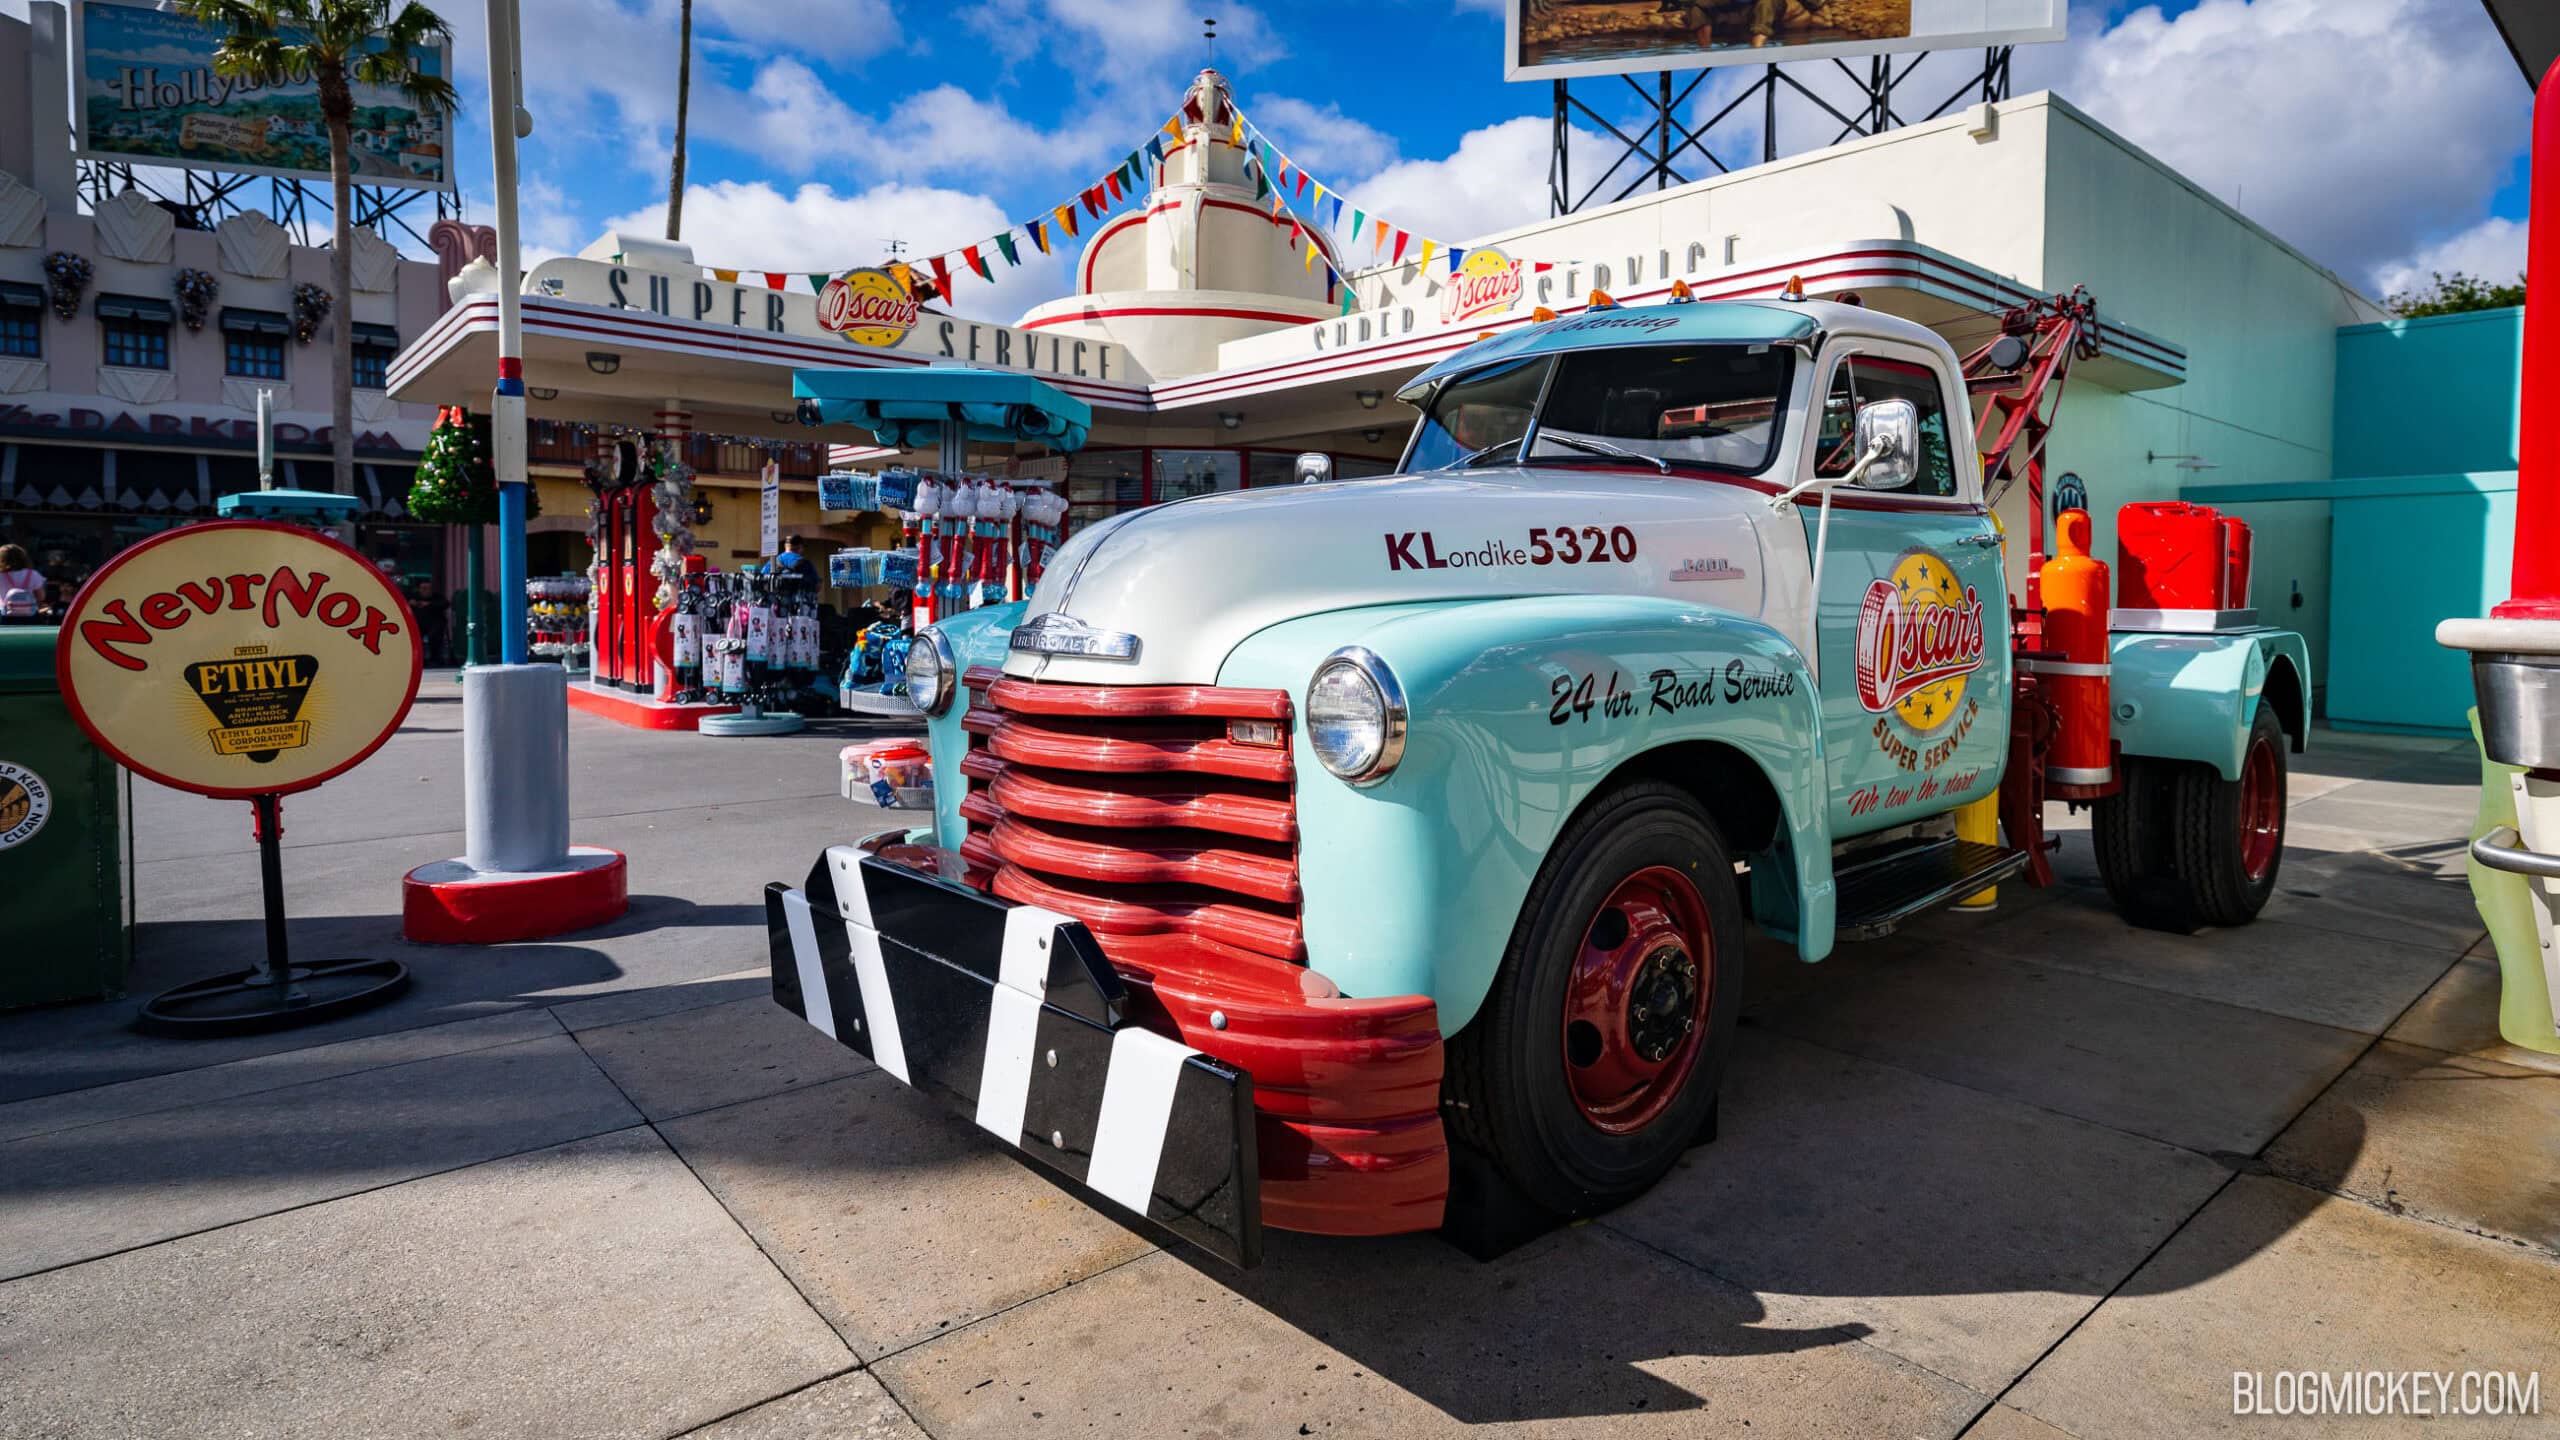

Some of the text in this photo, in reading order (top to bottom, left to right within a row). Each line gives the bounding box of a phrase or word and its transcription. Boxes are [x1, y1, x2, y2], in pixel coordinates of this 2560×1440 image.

[608, 268, 785, 334] SUPER
[817, 277, 919, 333] Oscar's
[1441, 259, 1523, 325] Oscar's
[938, 320, 1111, 380] SERVICE
[1856, 579, 1985, 713] Oscar's
[198, 659, 308, 694] ETHYL
[1549, 674, 1594, 725] 24
[1650, 667, 1715, 716] Road
[1724, 658, 1796, 704] Service
[221, 724, 299, 739] ETHYL GASOLINE
[228, 708, 289, 720] ANTI-KNOCK
[228, 733, 294, 746] CORPORATION
[1872, 697, 1980, 771] SUPER SERVICE
[18, 772, 46, 799] KEEP
[1848, 767, 1980, 817] We tow the stars!
[4, 812, 44, 843] CLEAN
